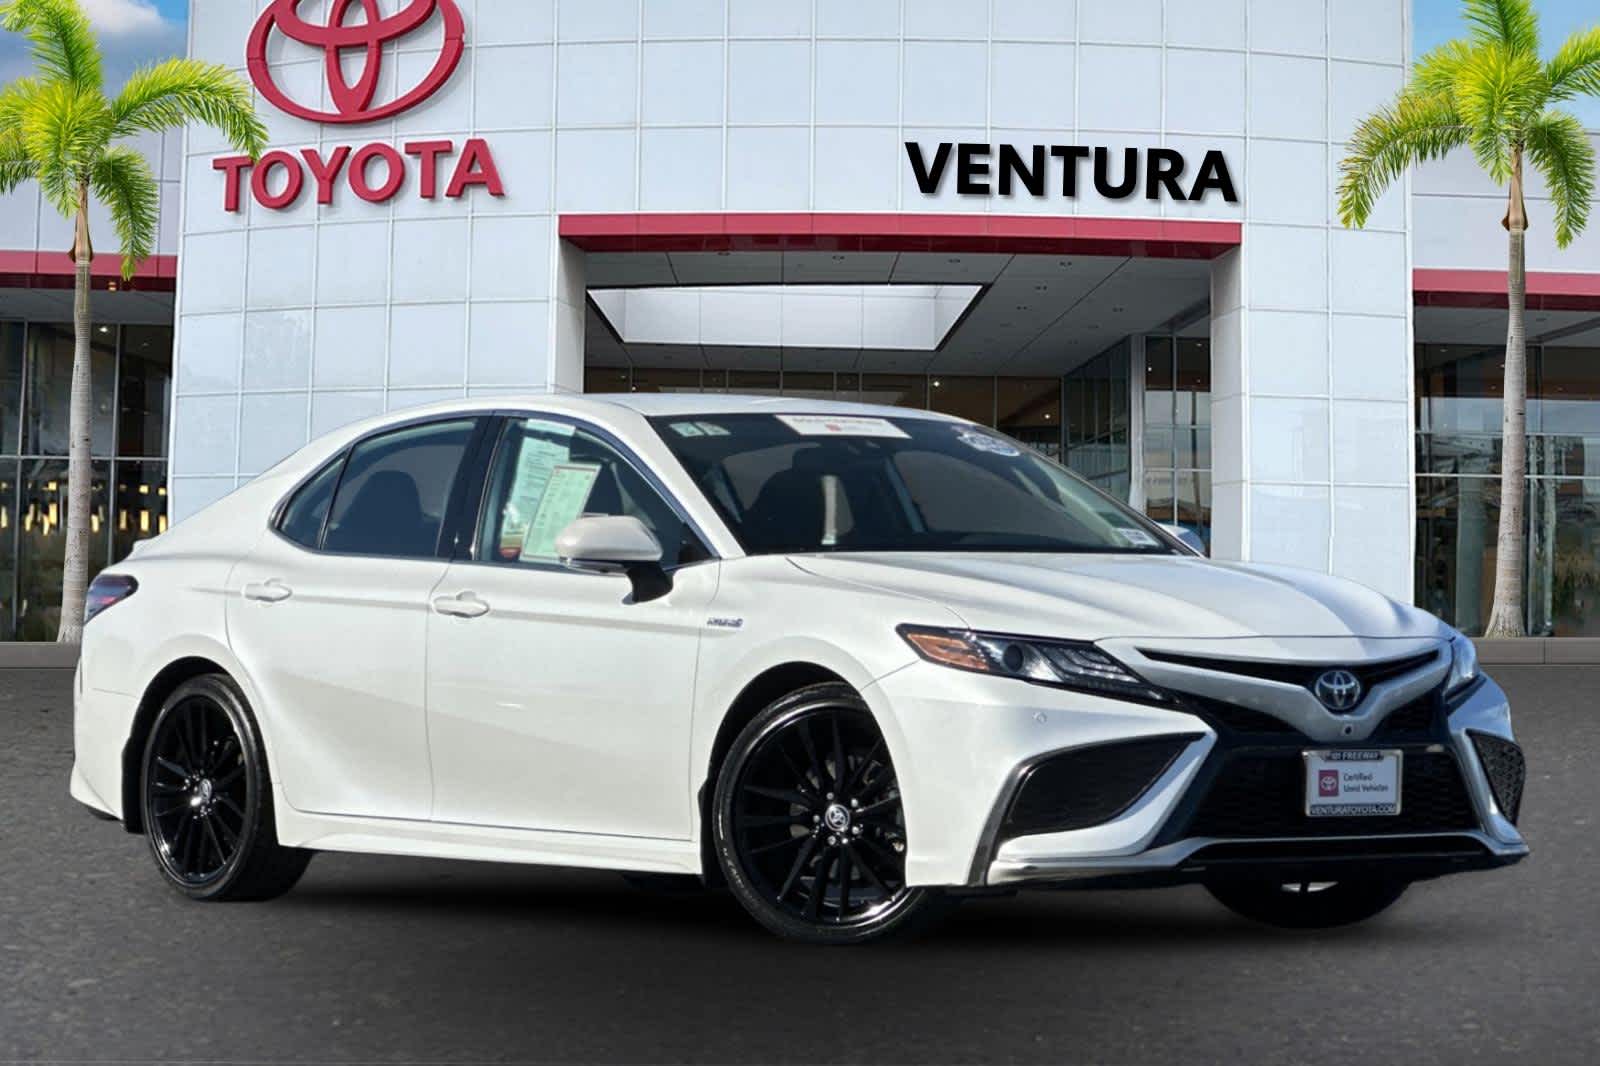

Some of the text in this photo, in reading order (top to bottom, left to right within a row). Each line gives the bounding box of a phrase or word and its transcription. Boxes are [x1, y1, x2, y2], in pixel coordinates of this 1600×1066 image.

[212, 138, 505, 212] TOYOTA
[904, 142, 1238, 202] VENTURA
[1342, 751, 1378, 760] FREEWAY
[1343, 772, 1373, 781] Certified
[1343, 784, 1389, 792] Used Vehicles
